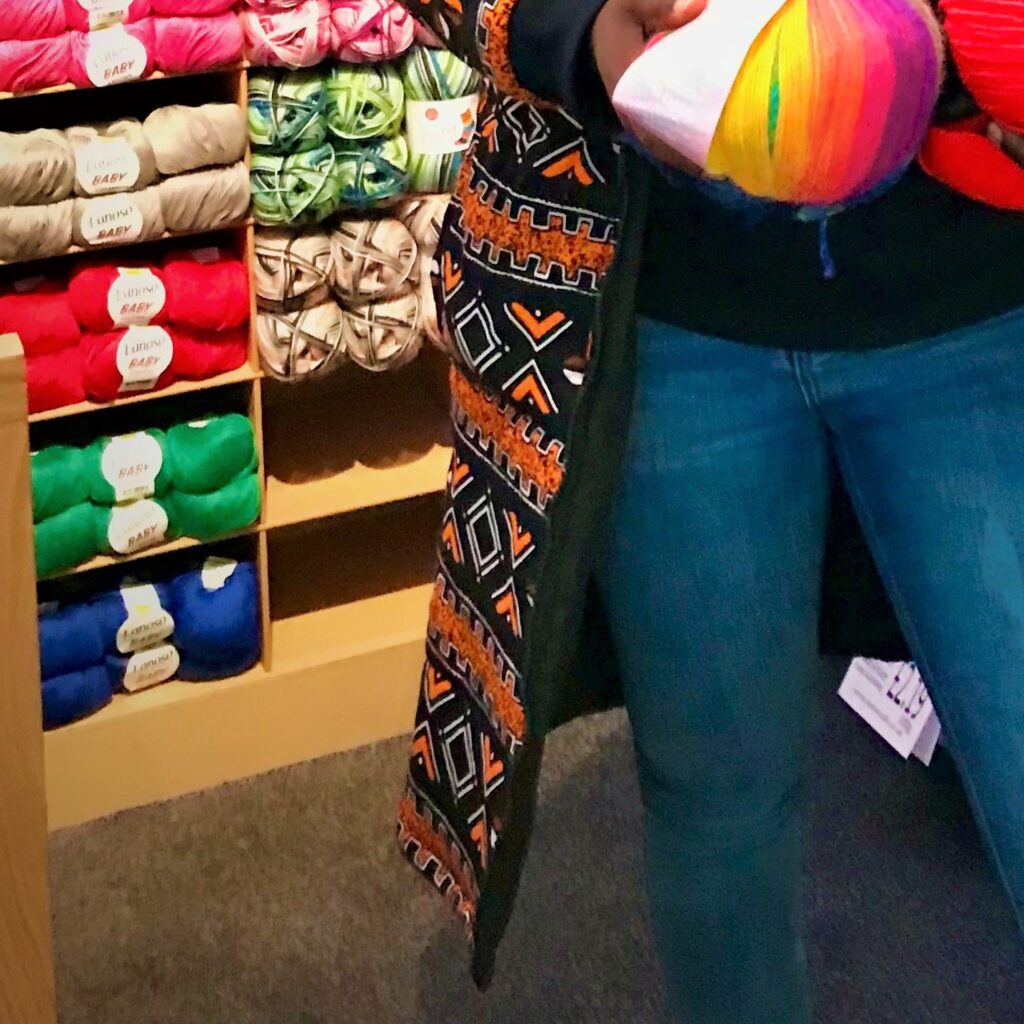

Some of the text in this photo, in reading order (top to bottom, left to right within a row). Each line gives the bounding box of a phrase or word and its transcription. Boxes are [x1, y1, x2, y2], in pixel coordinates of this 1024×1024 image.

[103, 59, 136, 80] BABY
[91, 171, 129, 187] BABY
[119, 300, 153, 314] BABY
[127, 355, 161, 370] BABY
[127, 524, 159, 548] BABY
